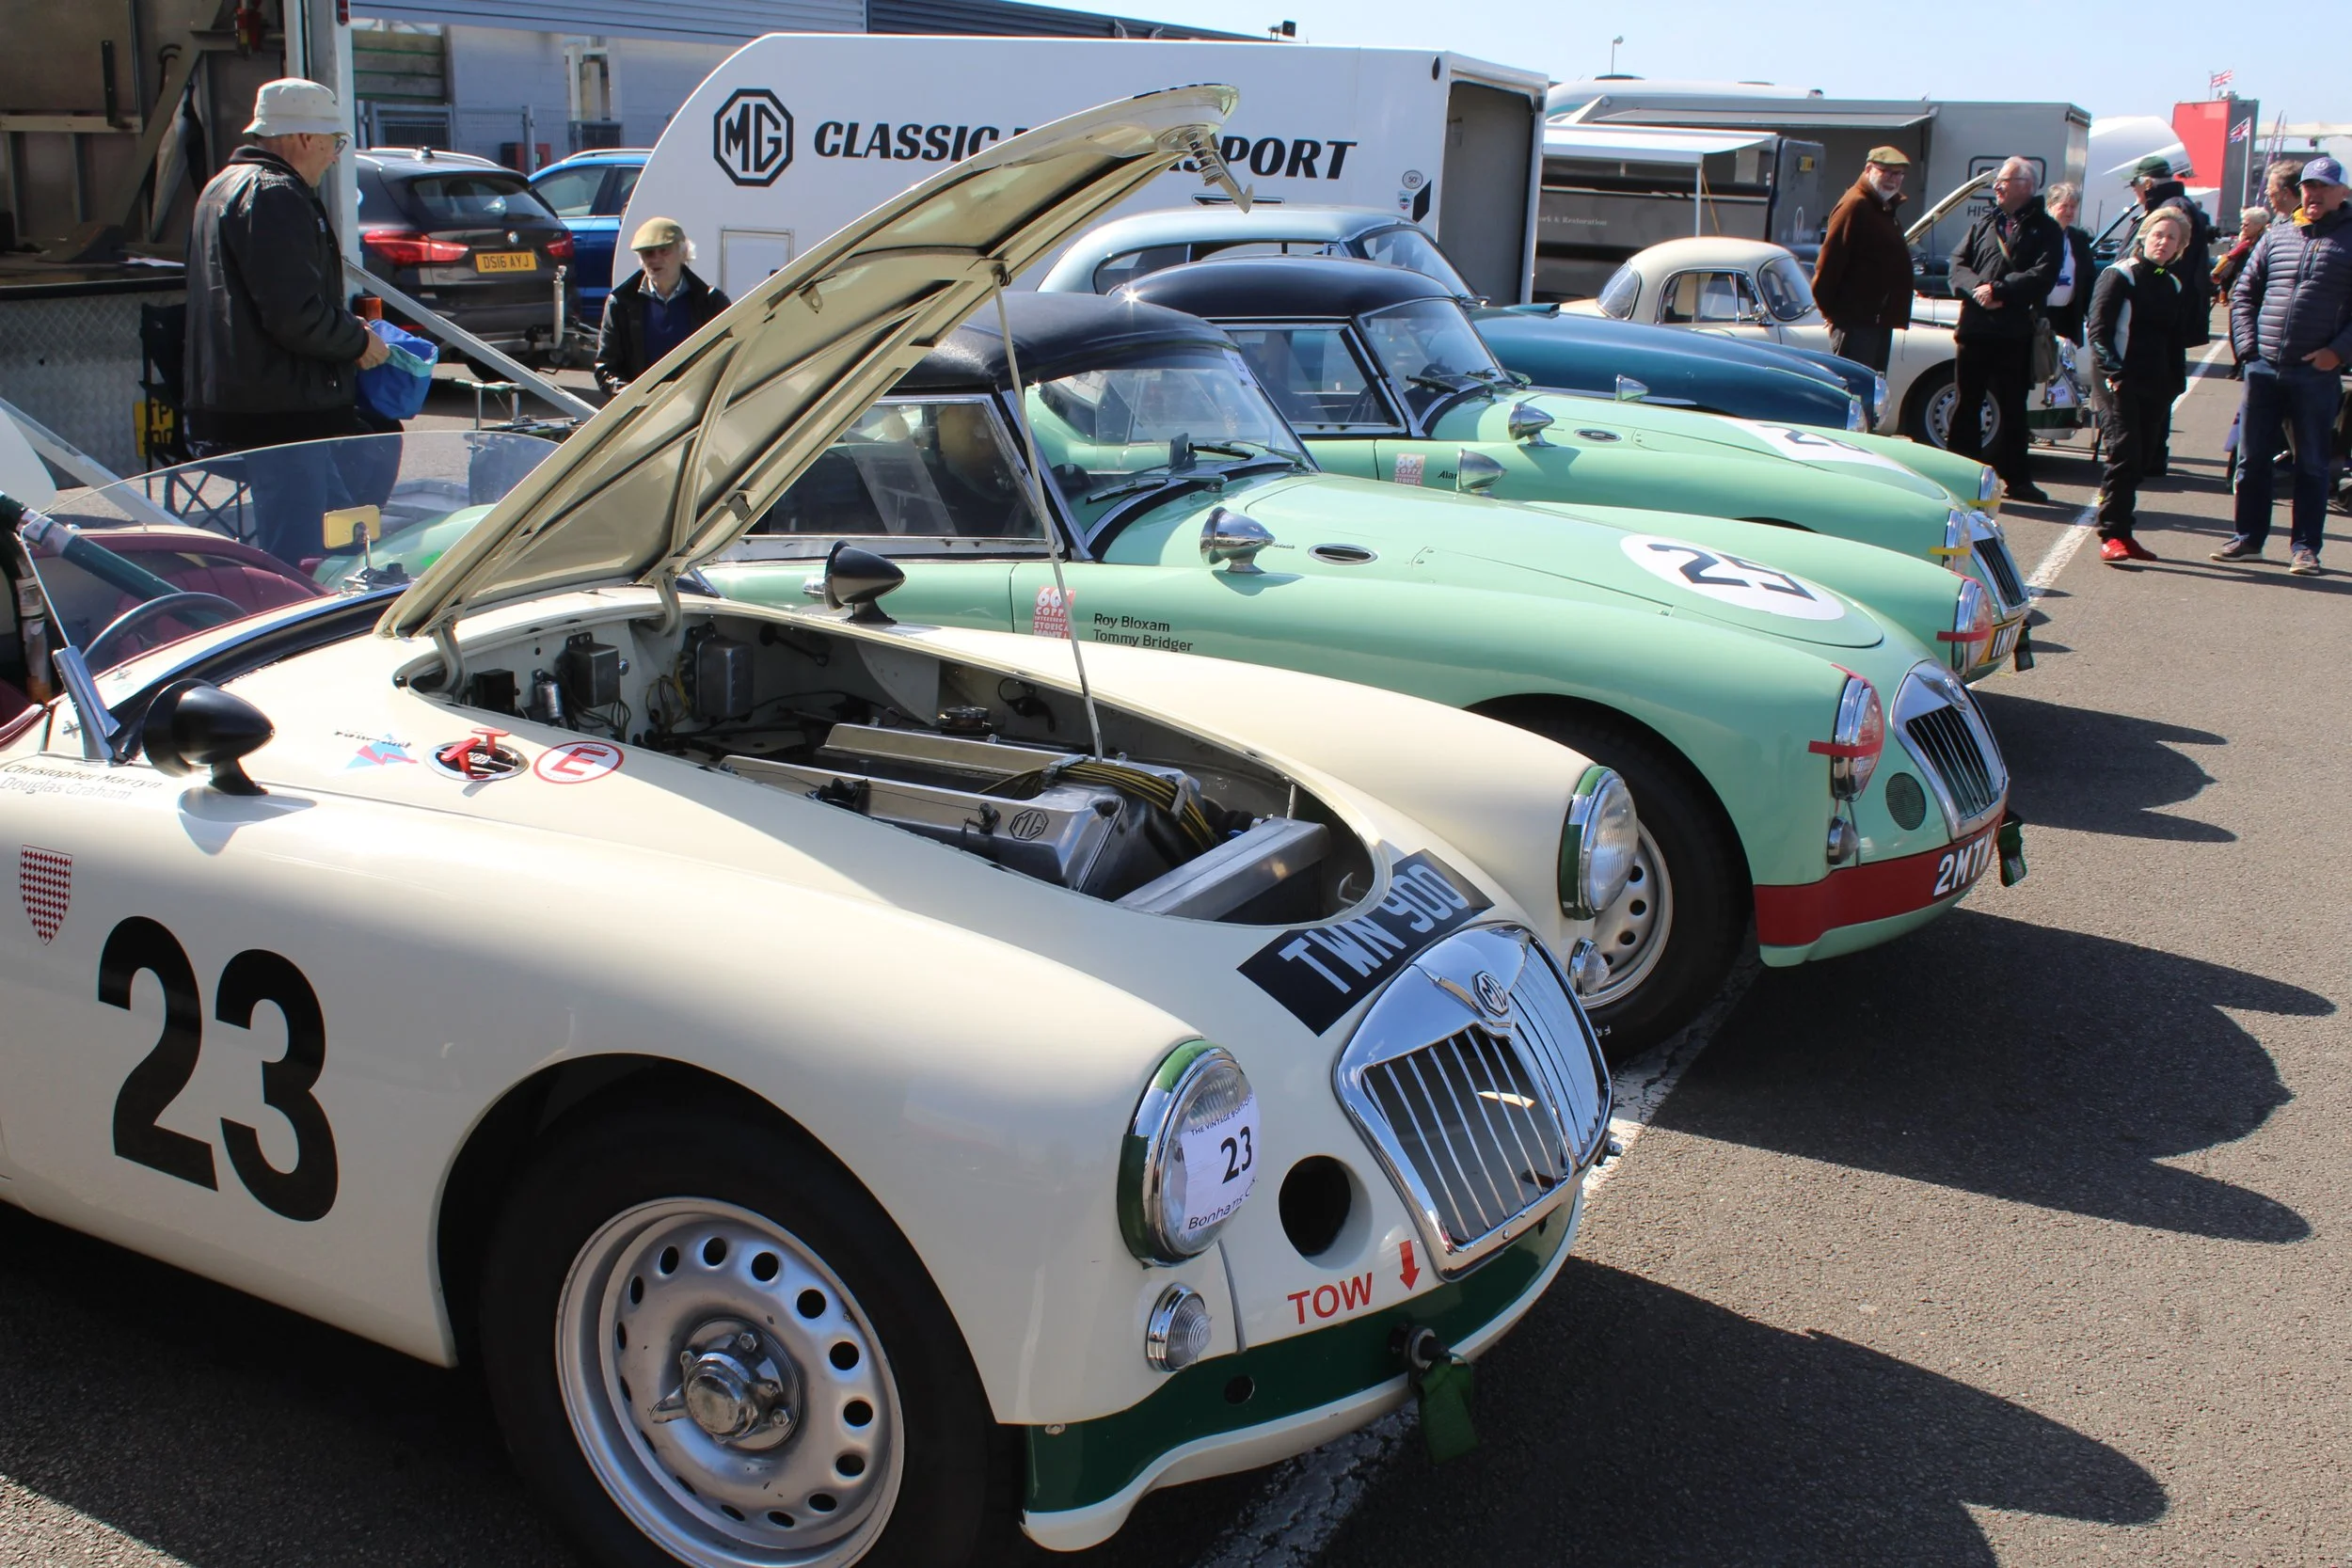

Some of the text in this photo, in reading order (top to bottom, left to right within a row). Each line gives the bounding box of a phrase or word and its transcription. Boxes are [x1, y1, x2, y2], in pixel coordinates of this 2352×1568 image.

[723, 101, 785, 175] MG
[813, 120, 1001, 163] CLASSIC
[1563, 215, 1608, 227] Restoration
[482, 254, 530, 270] DS16 AYJ
[1646, 543, 1818, 603] 25
[1035, 606, 1067, 618] COPP
[1093, 612, 1170, 633] Roy Bloxam
[1093, 628, 1194, 653] Tommy Bridger
[549, 746, 610, 776] E
[0, 776, 133, 800] Douglas Graham
[4, 764, 163, 789] Christopher Martyn
[1011, 811, 1046, 838] MG
[1277, 863, 1470, 995] TWN 900
[97, 914, 340, 1223] 23
[1190, 1113, 1232, 1137] THE VINTAGE
[1220, 1125, 1253, 1185] 23
[1286, 1271, 1374, 1325] TOW
